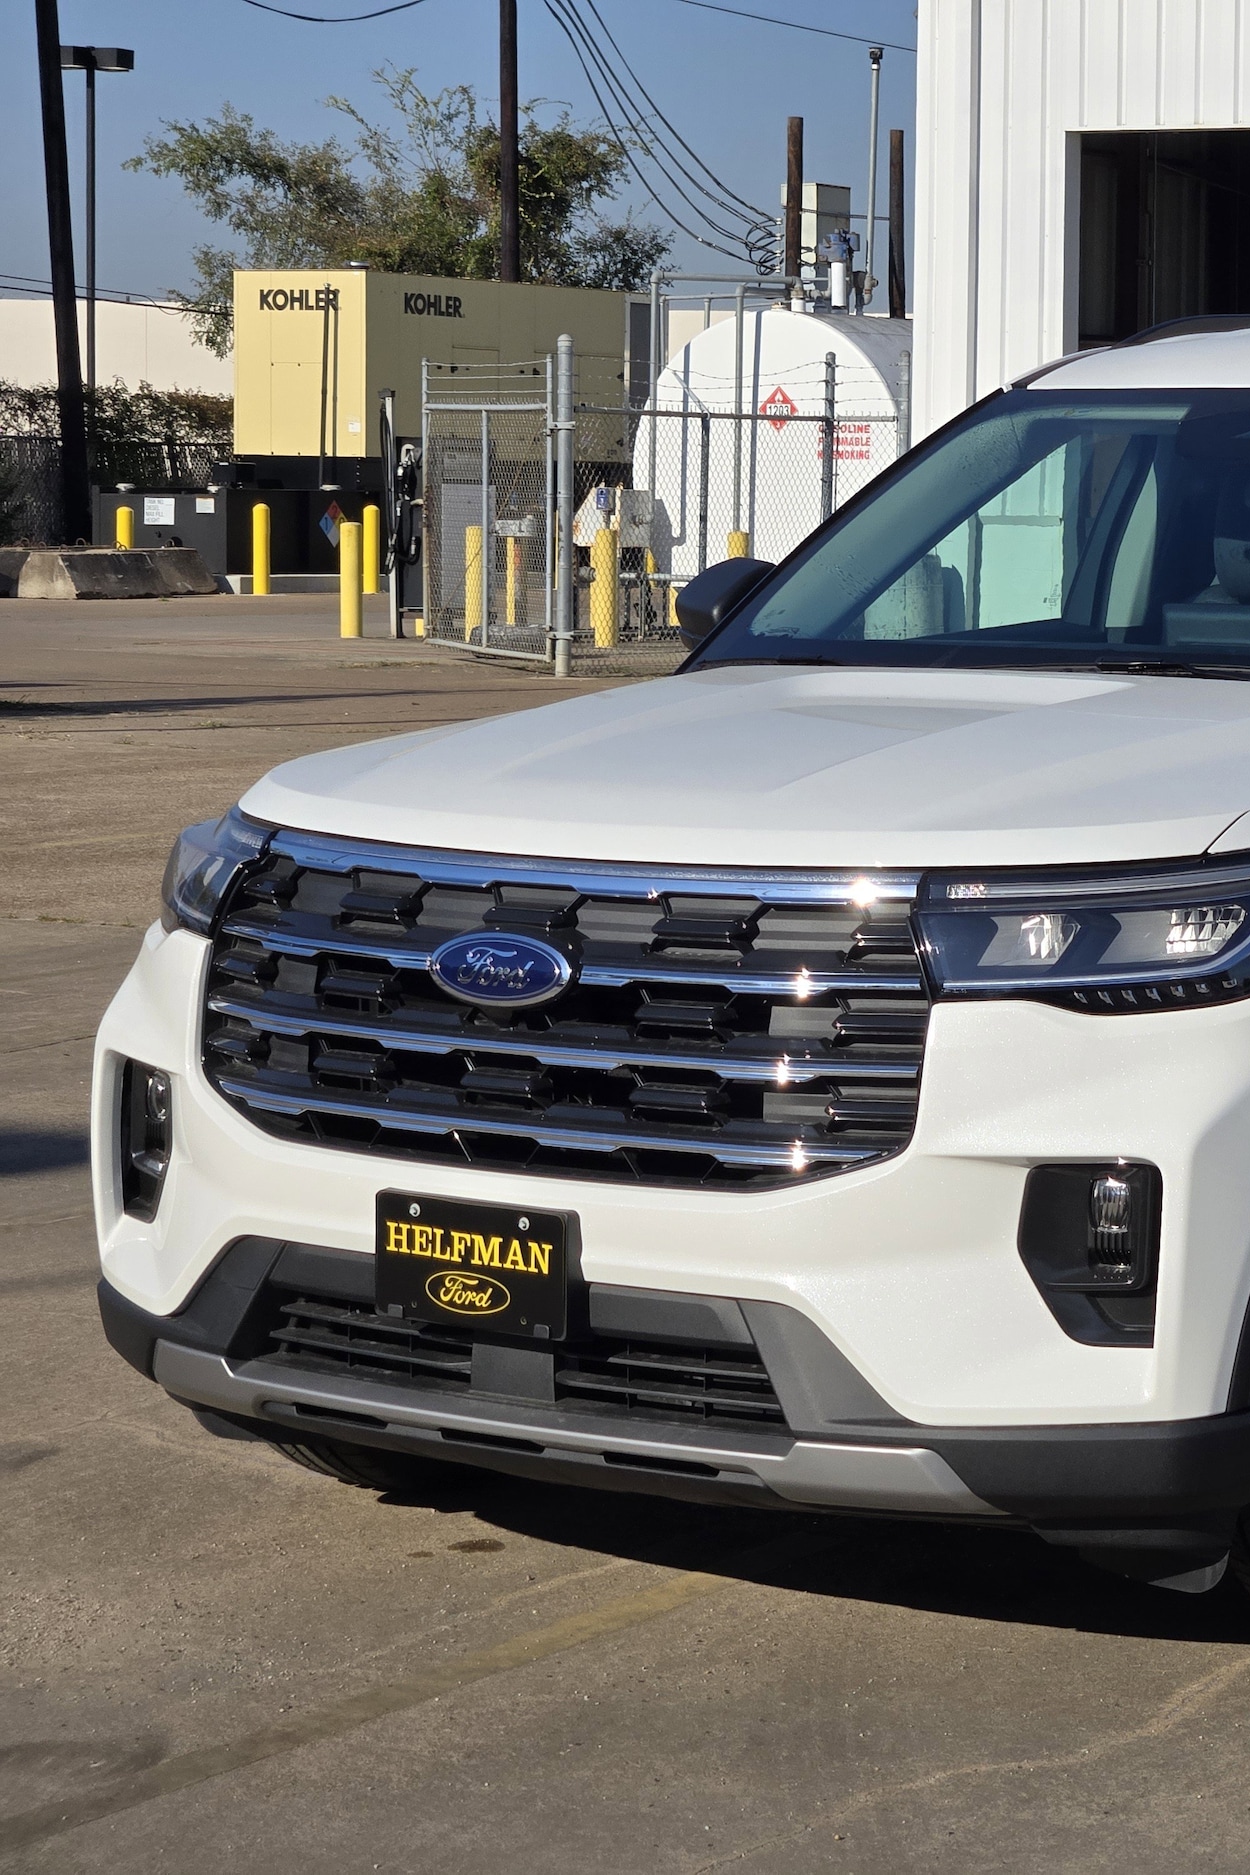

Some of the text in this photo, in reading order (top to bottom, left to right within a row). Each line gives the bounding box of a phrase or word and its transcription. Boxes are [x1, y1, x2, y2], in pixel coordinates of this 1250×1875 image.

[259, 289, 339, 311] KOHLER
[404, 292, 463, 318] KOHLER
[768, 405, 790, 416] 1203
[818, 424, 871, 434] GSOLINE
[818, 437, 871, 447] FMMABLE
[457, 946, 535, 990] Ford
[385, 1220, 553, 1275] HELFMAN
[439, 1275, 493, 1308] Ford
